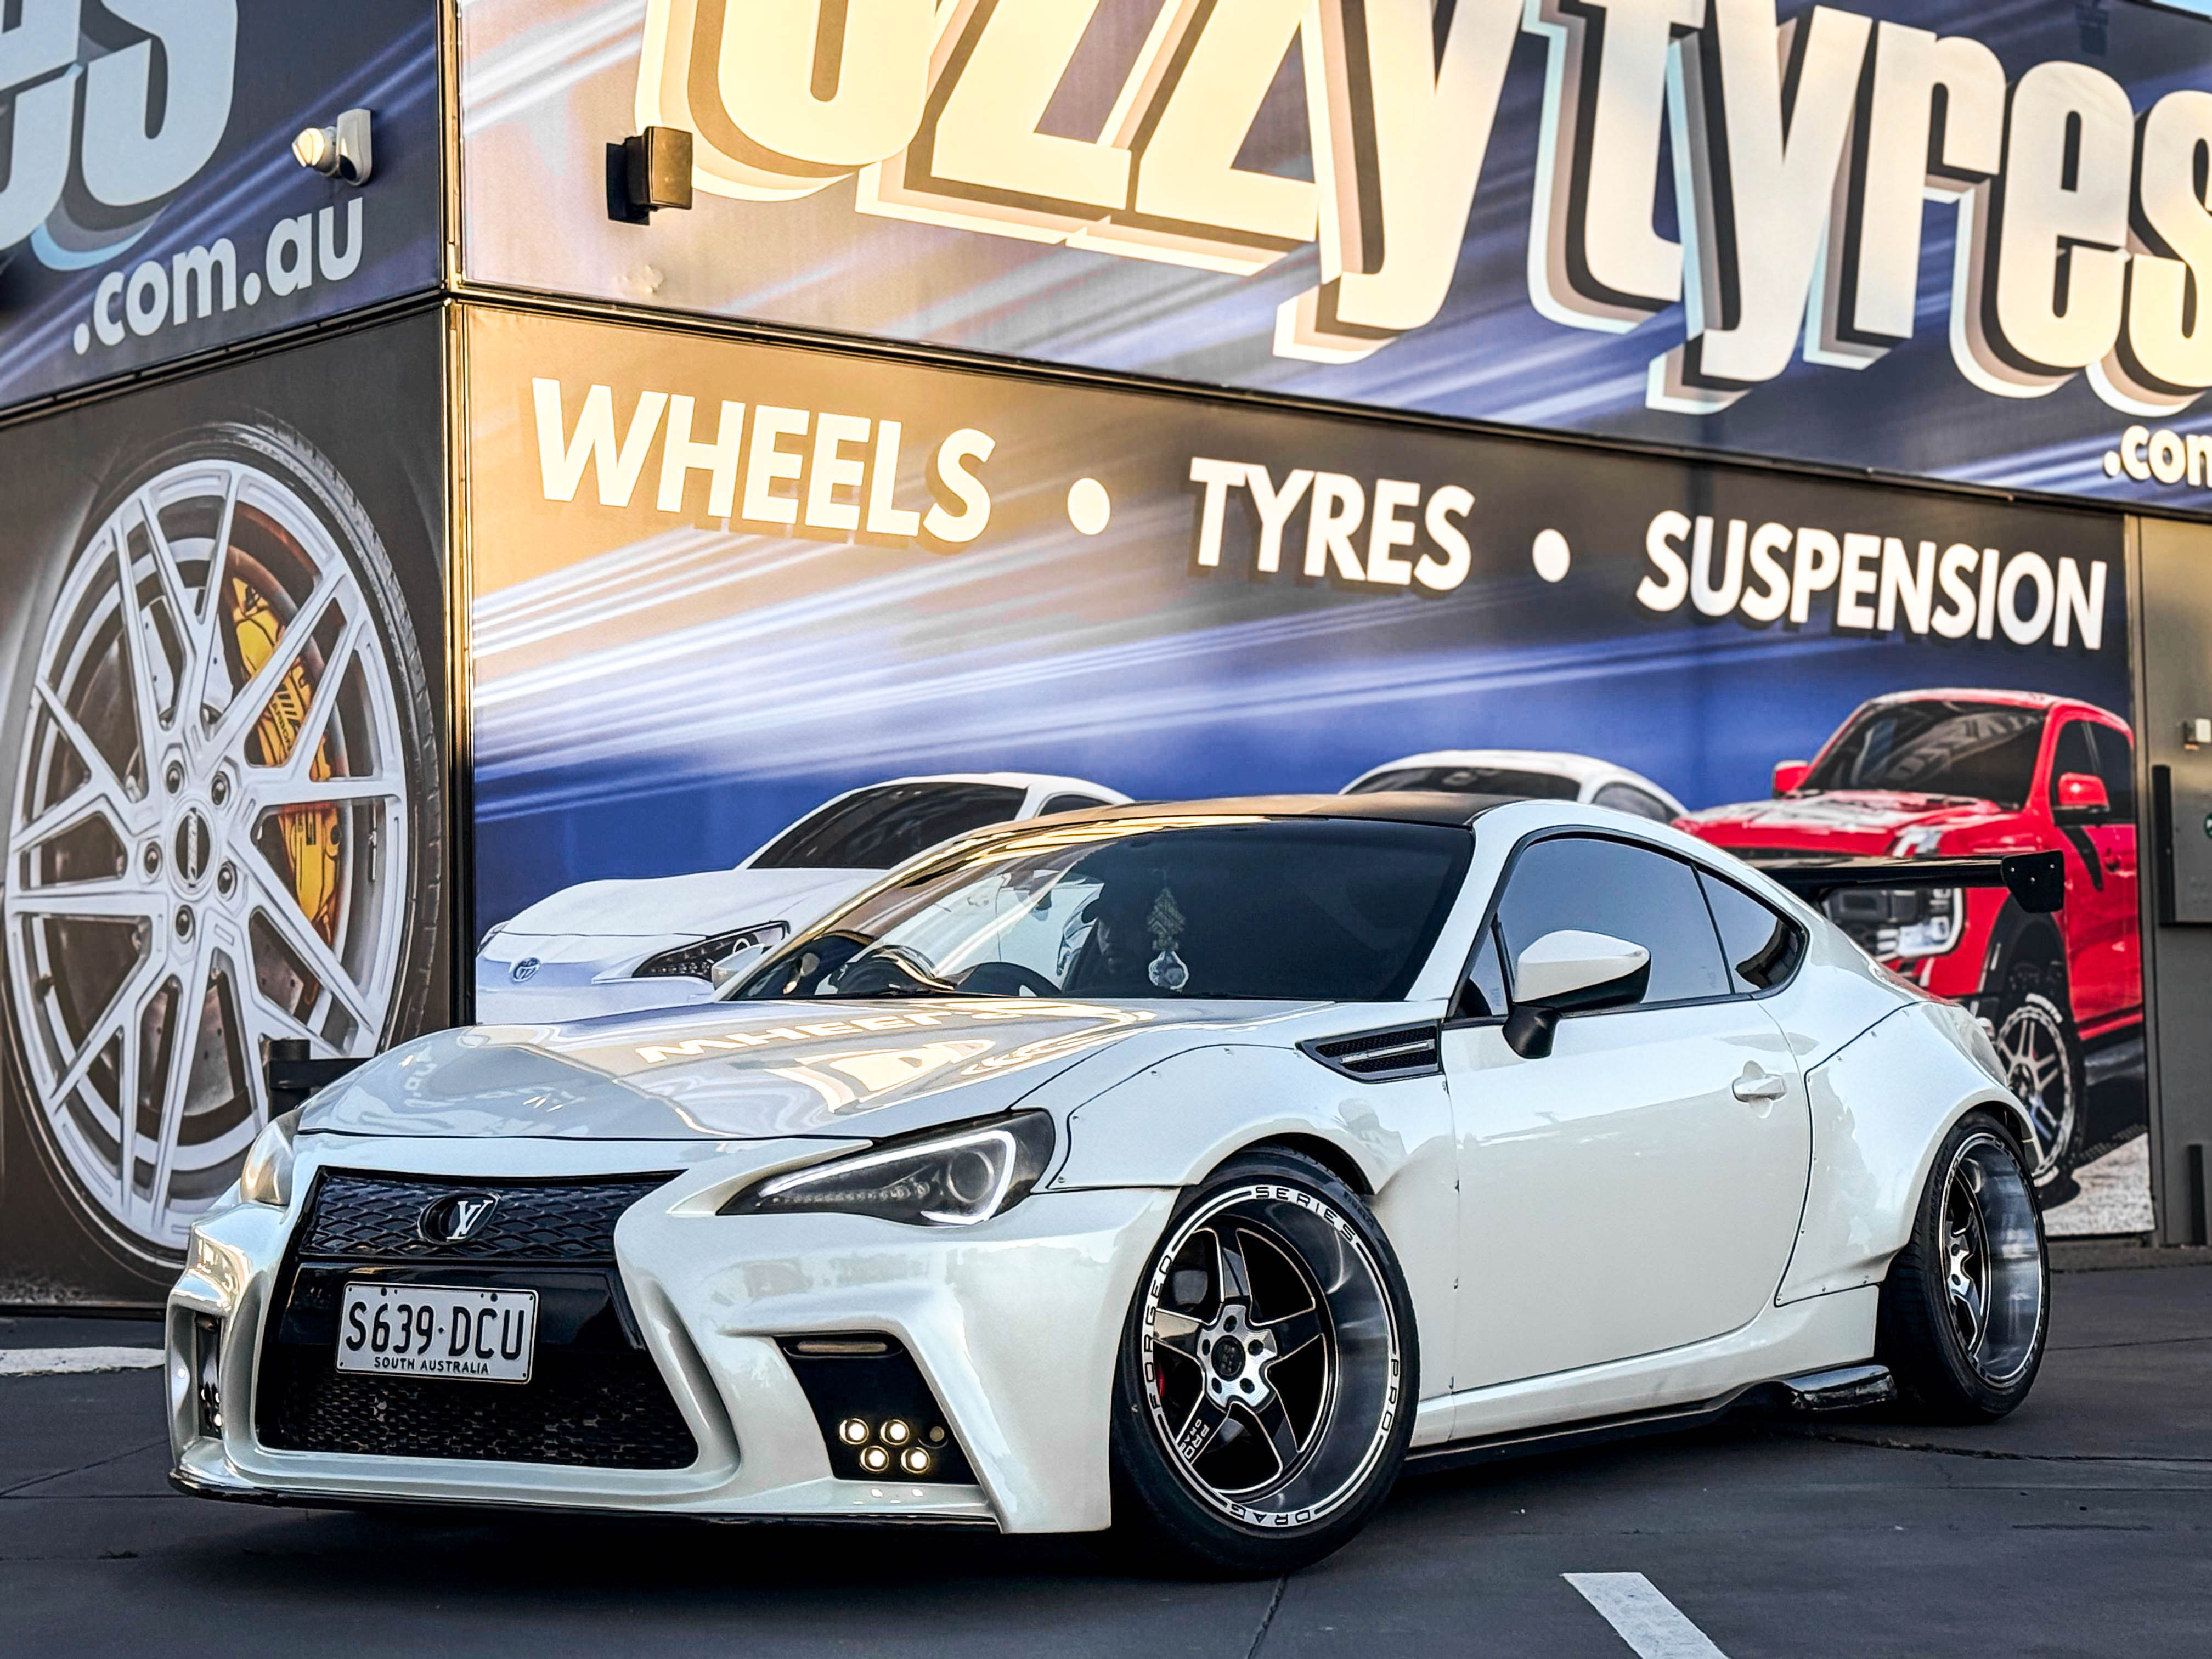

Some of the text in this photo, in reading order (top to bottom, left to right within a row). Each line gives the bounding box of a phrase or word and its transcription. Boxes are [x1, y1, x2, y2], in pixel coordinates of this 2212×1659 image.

[73, 197, 363, 356] .com.au
[532, 377, 2108, 650] WHEELS TYRES SUSPENSION
[1255, 1186, 1356, 1242] SERIES
[374, 1356, 489, 1375] SOUTH AUSTRALIA
[1144, 1255, 1172, 1409] FORGED
[1381, 1358, 1399, 1431] PRO
[1229, 1503, 1311, 1525] DRAG
